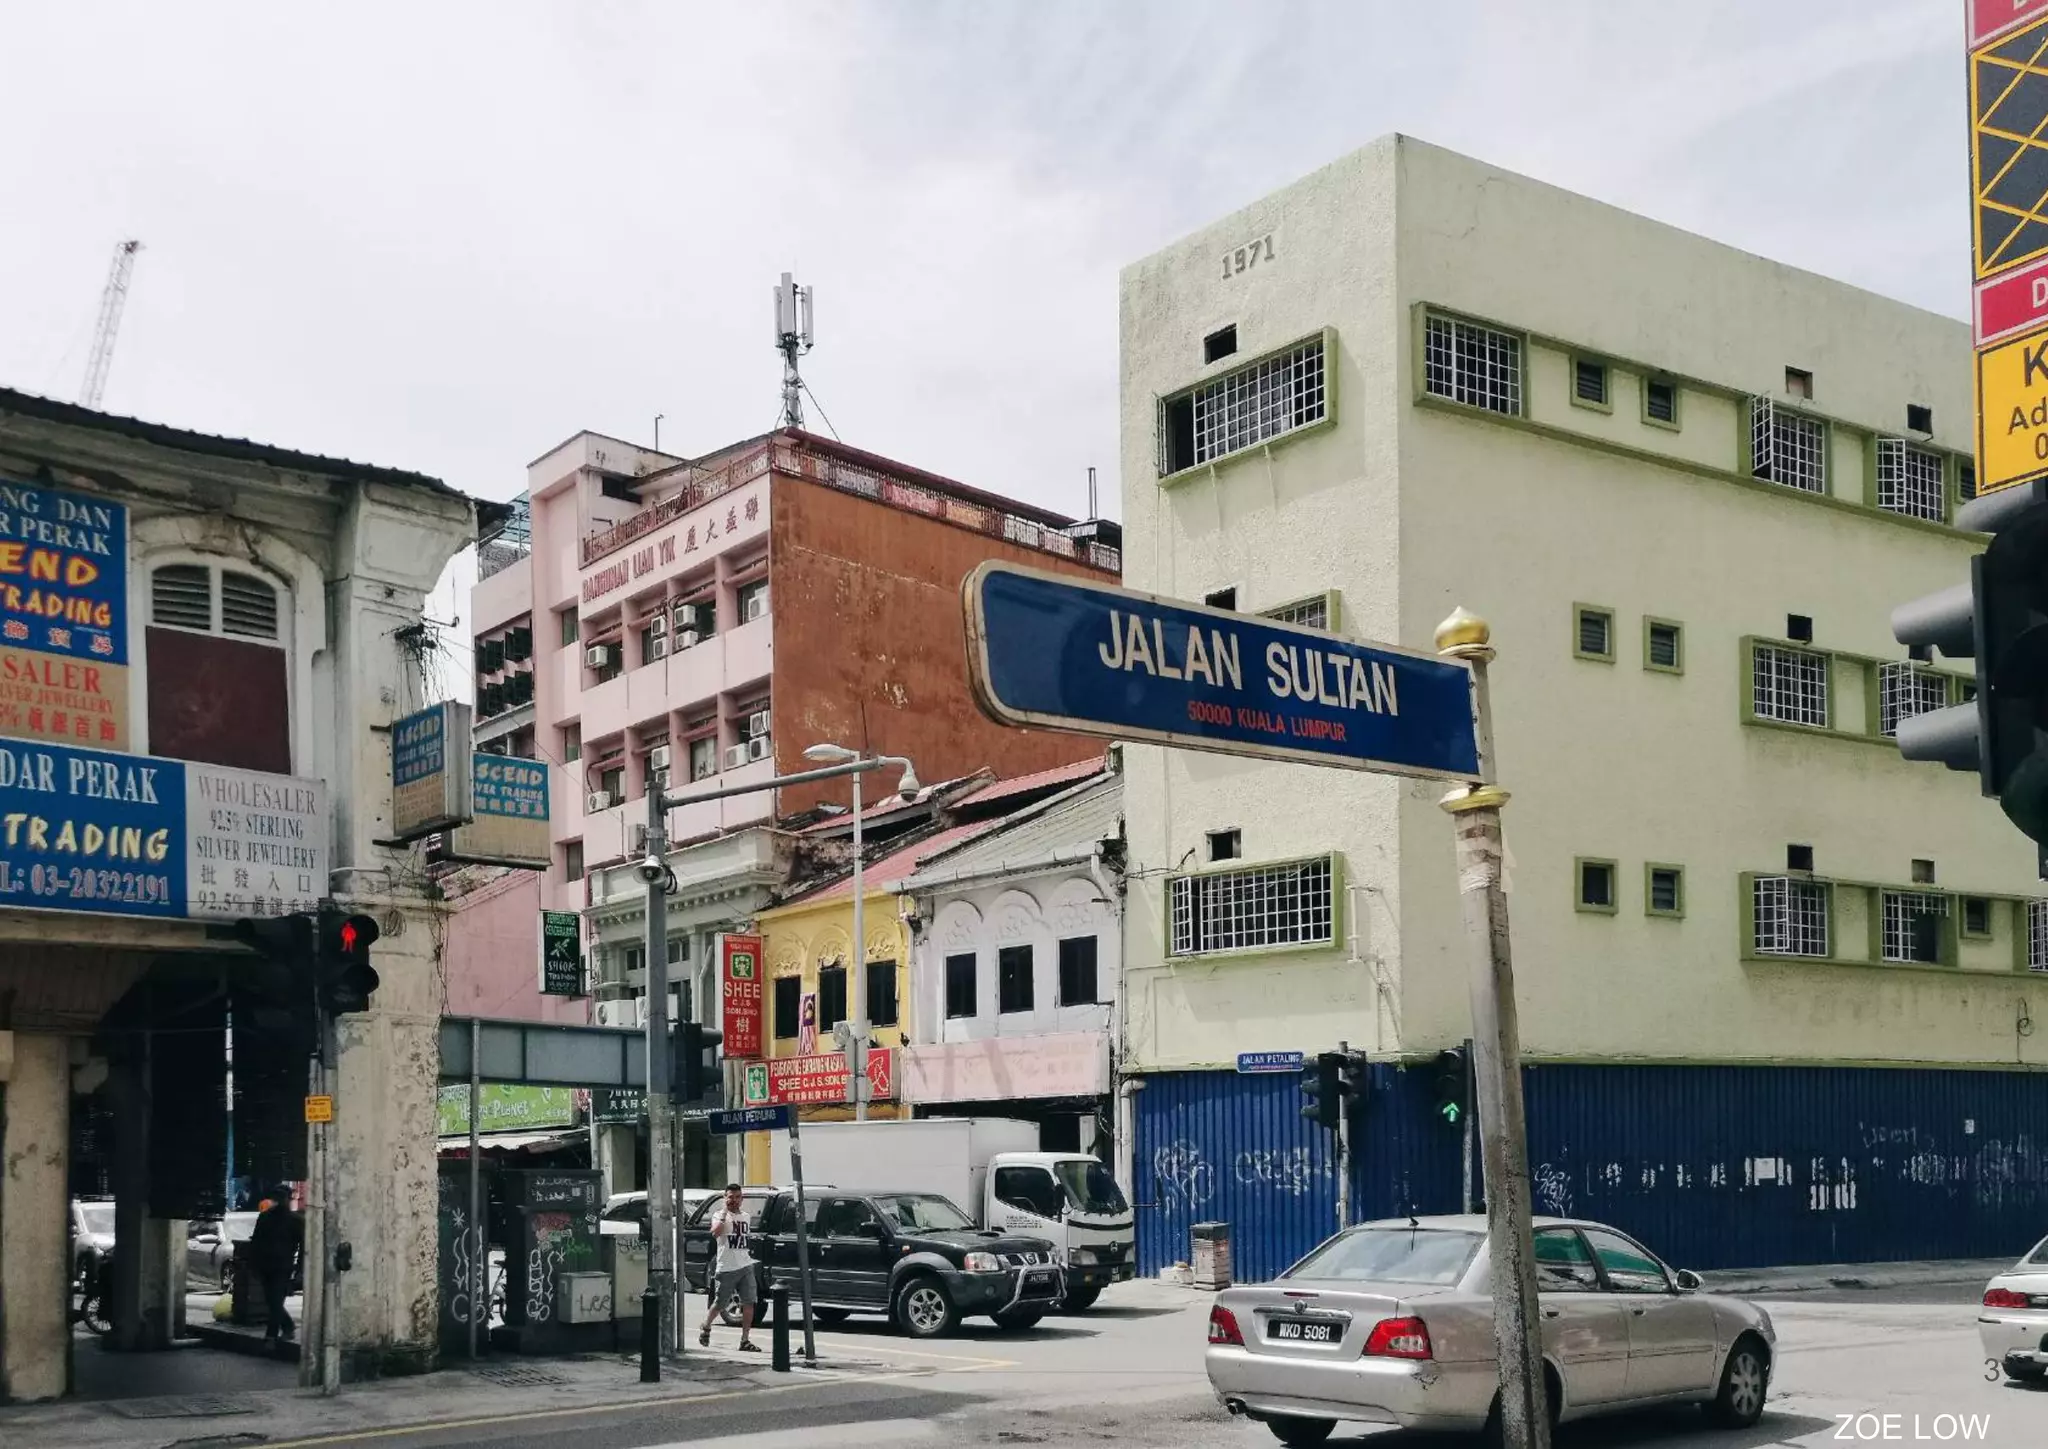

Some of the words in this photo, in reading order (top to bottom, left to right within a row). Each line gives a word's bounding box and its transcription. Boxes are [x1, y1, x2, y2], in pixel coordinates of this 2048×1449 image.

[1222, 234, 1275, 280] 1971
[58, 498, 112, 531] DAN
[20, 515, 112, 556] PERAK
[3, 654, 102, 694] SALER
[1099, 609, 1242, 690] JALAN
[1266, 641, 1399, 716] SULTAN
[1187, 700, 1232, 727] 50000
[1237, 708, 1286, 734] KUALA
[1291, 716, 1347, 742] LUMPUR
[0, 748, 56, 792] DAR
[69, 757, 159, 805] PERAK
[198, 775, 317, 816] WHOLESALER
[4, 812, 170, 862] TRADING
[246, 813, 304, 840] STERLING
[196, 836, 241, 861] SILVER
[246, 842, 317, 870] JEWELLERY
[31, 864, 170, 905] 03-20322191
[724, 981, 760, 998] SHEE
[1242, 1054, 1264, 1064] JALAN
[1267, 1053, 1301, 1063] PETALING
[778, 1078, 801, 1091] SHEE
[732, 1220, 749, 1235] NO
[1279, 1323, 1301, 1338] WKD
[1304, 1325, 1330, 1340] 5081
